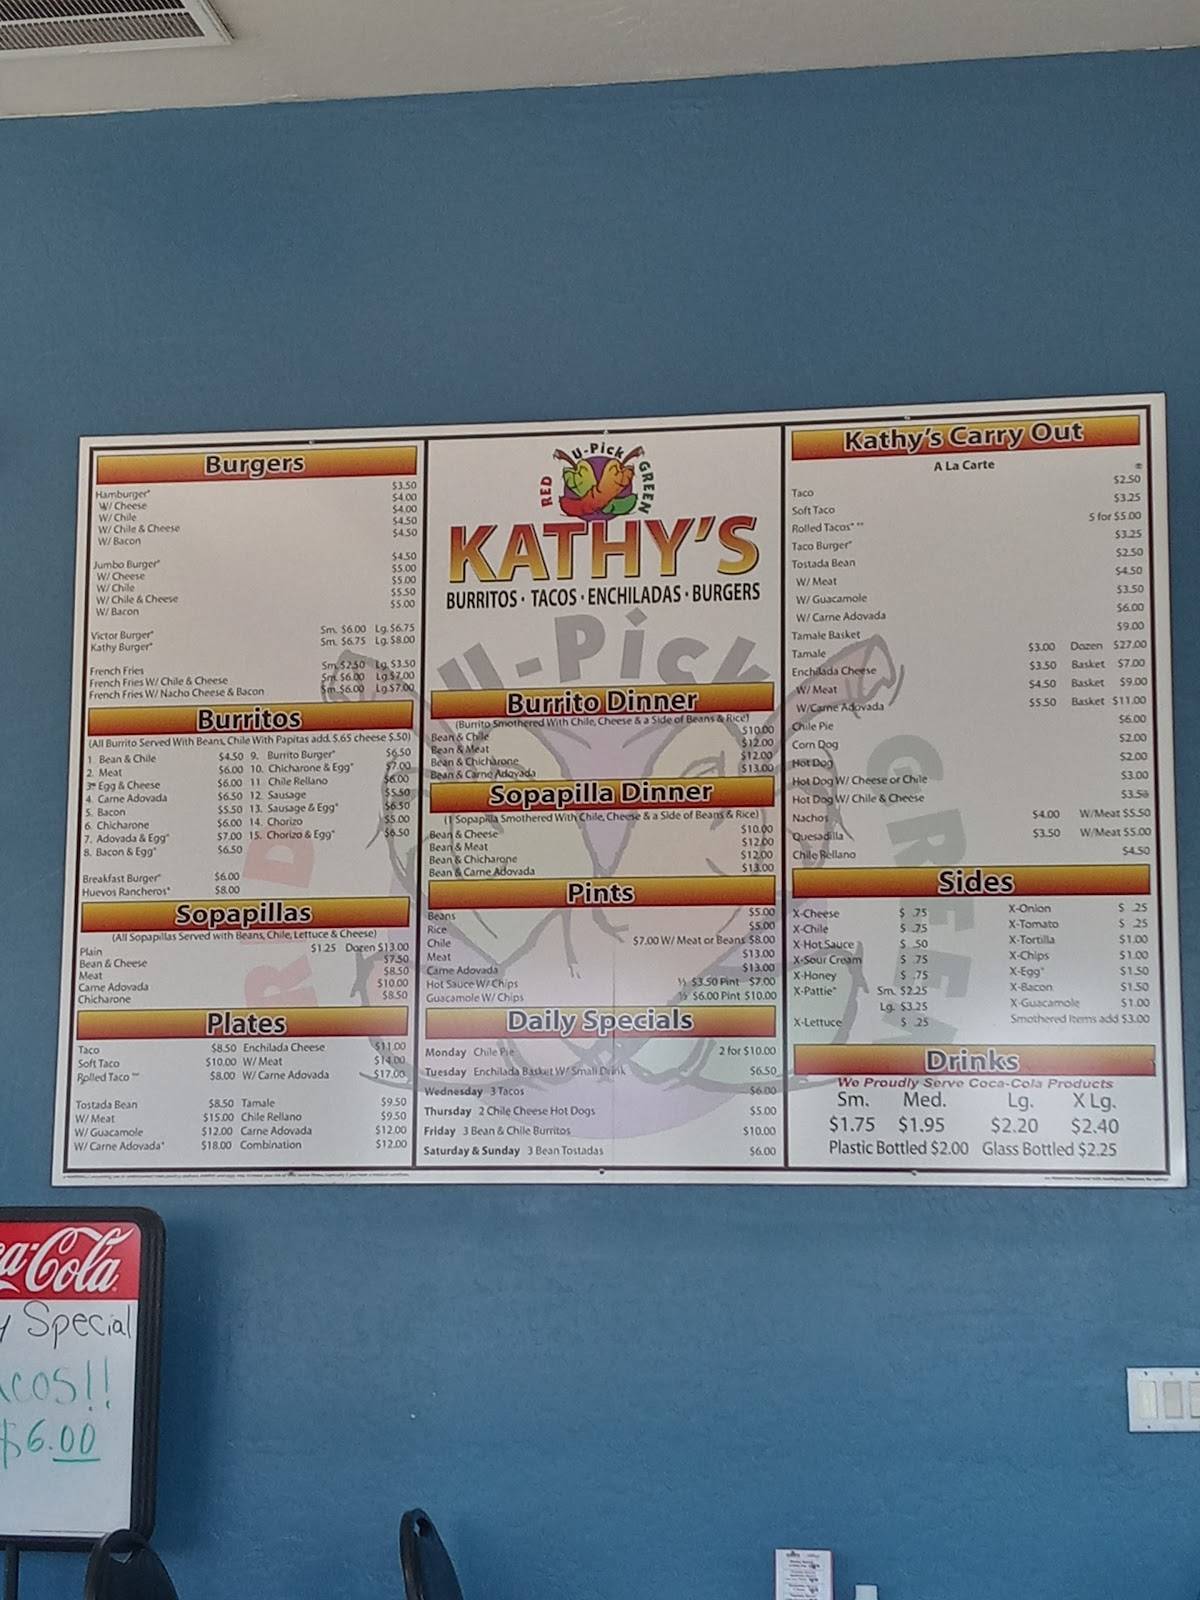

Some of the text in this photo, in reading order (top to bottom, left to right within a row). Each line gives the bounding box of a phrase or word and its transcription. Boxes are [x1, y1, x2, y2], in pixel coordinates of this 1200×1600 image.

[844, 421, 1083, 453] Kathy's Carry Out
[205, 455, 304, 477] Burgers
[934, 460, 995, 471] A La Carte
[540, 476, 553, 507] RED
[638, 461, 655, 514] GREEN
[792, 474, 1141, 498] Taco $2.50
[114, 500, 147, 511] Cheese
[392, 493, 417, 502] $4.00
[792, 493, 1141, 515] Soft Taco $3.25
[1097, 511, 1142, 521] for $5.00
[113, 536, 141, 546] Bacon
[393, 528, 418, 538] $4.50
[449, 515, 759, 583] KATHY'S
[446, 582, 760, 610] BURRITOS TACOS ENCHILADAS BURGERS
[341, 625, 367, 634] $6.00
[390, 623, 415, 633] $6.75
[1113, 640, 1147, 650] $27.00
[90, 666, 144, 676] French Fries
[1072, 658, 1146, 669] Basket $7.00
[89, 690, 120, 700] French
[122, 689, 145, 699] Fries
[193, 688, 225, 697] Cheese
[236, 687, 264, 696] Bacon
[507, 690, 697, 714] Burrito Dinner
[197, 709, 301, 730] Burritos
[792, 733, 1147, 752] Corn Dog $2.00
[99, 755, 120, 764] Bean
[133, 754, 156, 763] Chile
[219, 752, 244, 762] $4.50
[490, 782, 713, 809] Sopapilla Dinner
[267, 817, 303, 827] Chorizo
[938, 871, 1014, 895] Sides
[567, 883, 634, 903] Pints
[175, 904, 311, 927] Sopapillas
[1009, 903, 1051, 913] X-Onion
[793, 909, 1059, 929] X-Cheese X-Tomato
[129, 931, 177, 943] Sopapillas
[633, 936, 659, 946] $7.00
[677, 936, 702, 945] Meat
[716, 934, 746, 945] Beans
[749, 934, 776, 945] $8.00
[793, 924, 1149, 944] X-Chile X-Tortilla $1.00
[80, 942, 409, 956] Plain $1.25 $13.00
[793, 950, 1149, 982] X-Honey X-Chips $1.00
[206, 1012, 286, 1035] Plates
[507, 1009, 693, 1036] Daily Specials
[425, 1048, 467, 1059] Monday
[727, 1045, 741, 1055] for
[743, 1046, 776, 1056] $10.00
[927, 1050, 1018, 1072] Drinks
[78, 1057, 237, 1068] Soft Taco $10.00
[425, 1066, 777, 1078] Tuesday $6.50
[1047, 1079, 1114, 1089] Products
[76, 1097, 407, 1110] Tostada Bean $8.50 Tamale $9.50
[904, 1092, 946, 1107] Med.
[1073, 1092, 1085, 1108] X
[424, 1106, 472, 1118] Thursday
[486, 1106, 511, 1117] Chile
[513, 1106, 548, 1116] Cheese
[550, 1106, 571, 1116] Hot
[572, 1106, 595, 1118] Dogs
[750, 1106, 777, 1116] $5.00
[90, 1128, 143, 1137] Guacamole
[240, 1126, 269, 1136] Carne
[270, 1126, 312, 1135] Adovada
[424, 1126, 776, 1138] Friday $10.00
[829, 1116, 1119, 1134] $1.75 $1.95 $2.20 $2.40
[240, 1139, 408, 1150] Combination $12.00
[424, 1146, 470, 1157] Saturday
[482, 1146, 520, 1157] Sunday
[535, 1146, 560, 1155] Bean
[561, 1145, 604, 1155] Tostadas
[750, 1146, 776, 1156] $6.00
[829, 1140, 1117, 1157] Plastic Bottled $2.00 Glass Bottled $2.25
[23, 1300, 131, 1350] Special
[0, 1418, 96, 1469] $6.00
